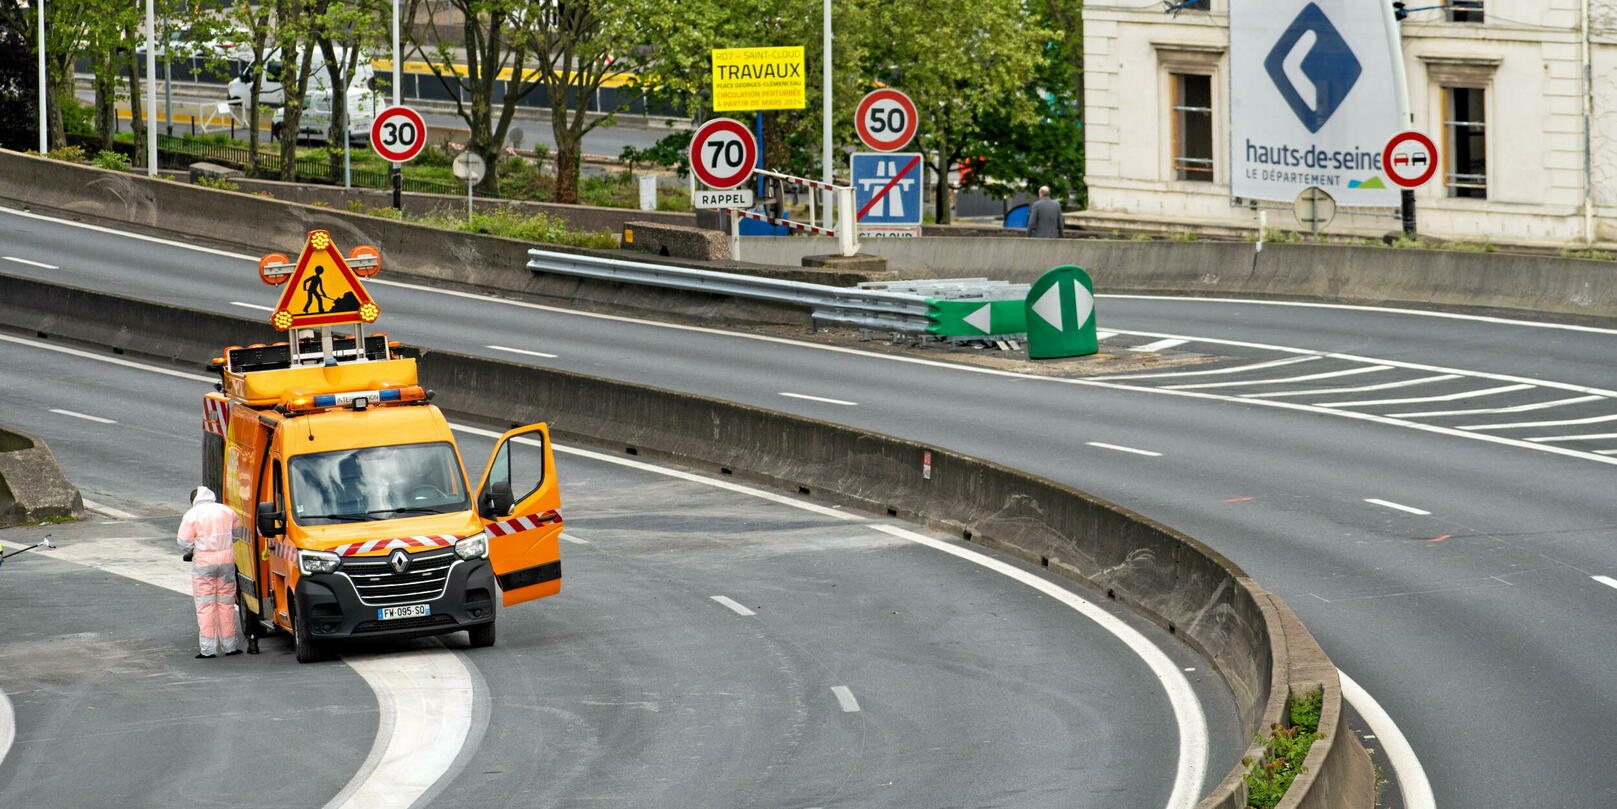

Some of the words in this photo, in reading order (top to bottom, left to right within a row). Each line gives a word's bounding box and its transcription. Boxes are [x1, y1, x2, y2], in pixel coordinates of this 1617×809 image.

[716, 52, 734, 60] RD7
[743, 50, 801, 60] SAINT-CLOUD
[716, 63, 800, 80] TRAVAUX
[762, 98, 782, 106] MARS
[869, 108, 905, 133] 50
[383, 122, 415, 146] 30
[707, 139, 744, 168] 70
[1246, 168, 1257, 179] LE
[1262, 169, 1341, 186] DÉPARTEMENT
[702, 194, 745, 204] RAPPEL
